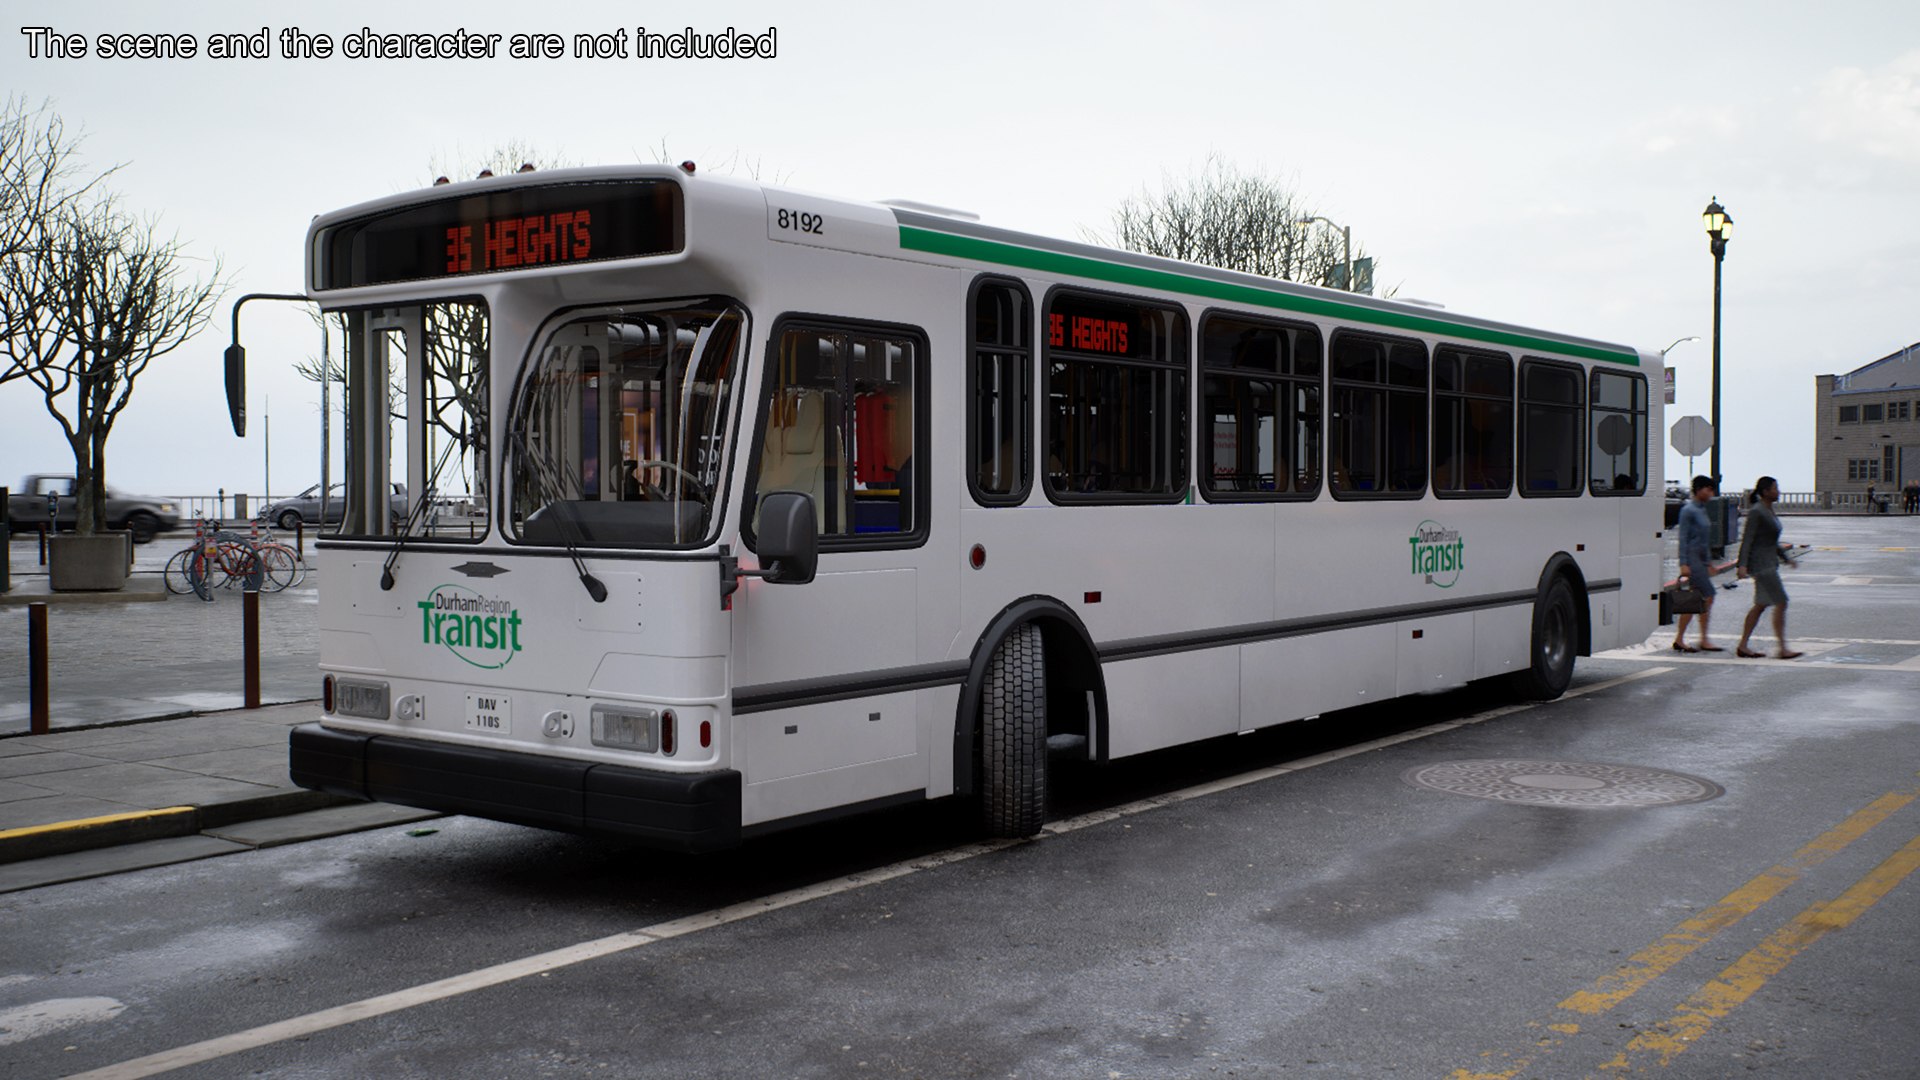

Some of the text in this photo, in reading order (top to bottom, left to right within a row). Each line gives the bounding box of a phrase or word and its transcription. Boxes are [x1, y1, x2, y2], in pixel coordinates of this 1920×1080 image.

[778, 208, 824, 235] 8192
[447, 210, 591, 273] 35 HEIGHTS
[1072, 315, 1128, 353] HEIGHTS
[1409, 536, 1464, 574] Transit
[417, 601, 522, 651] Transit
[478, 697, 497, 711] DAV
